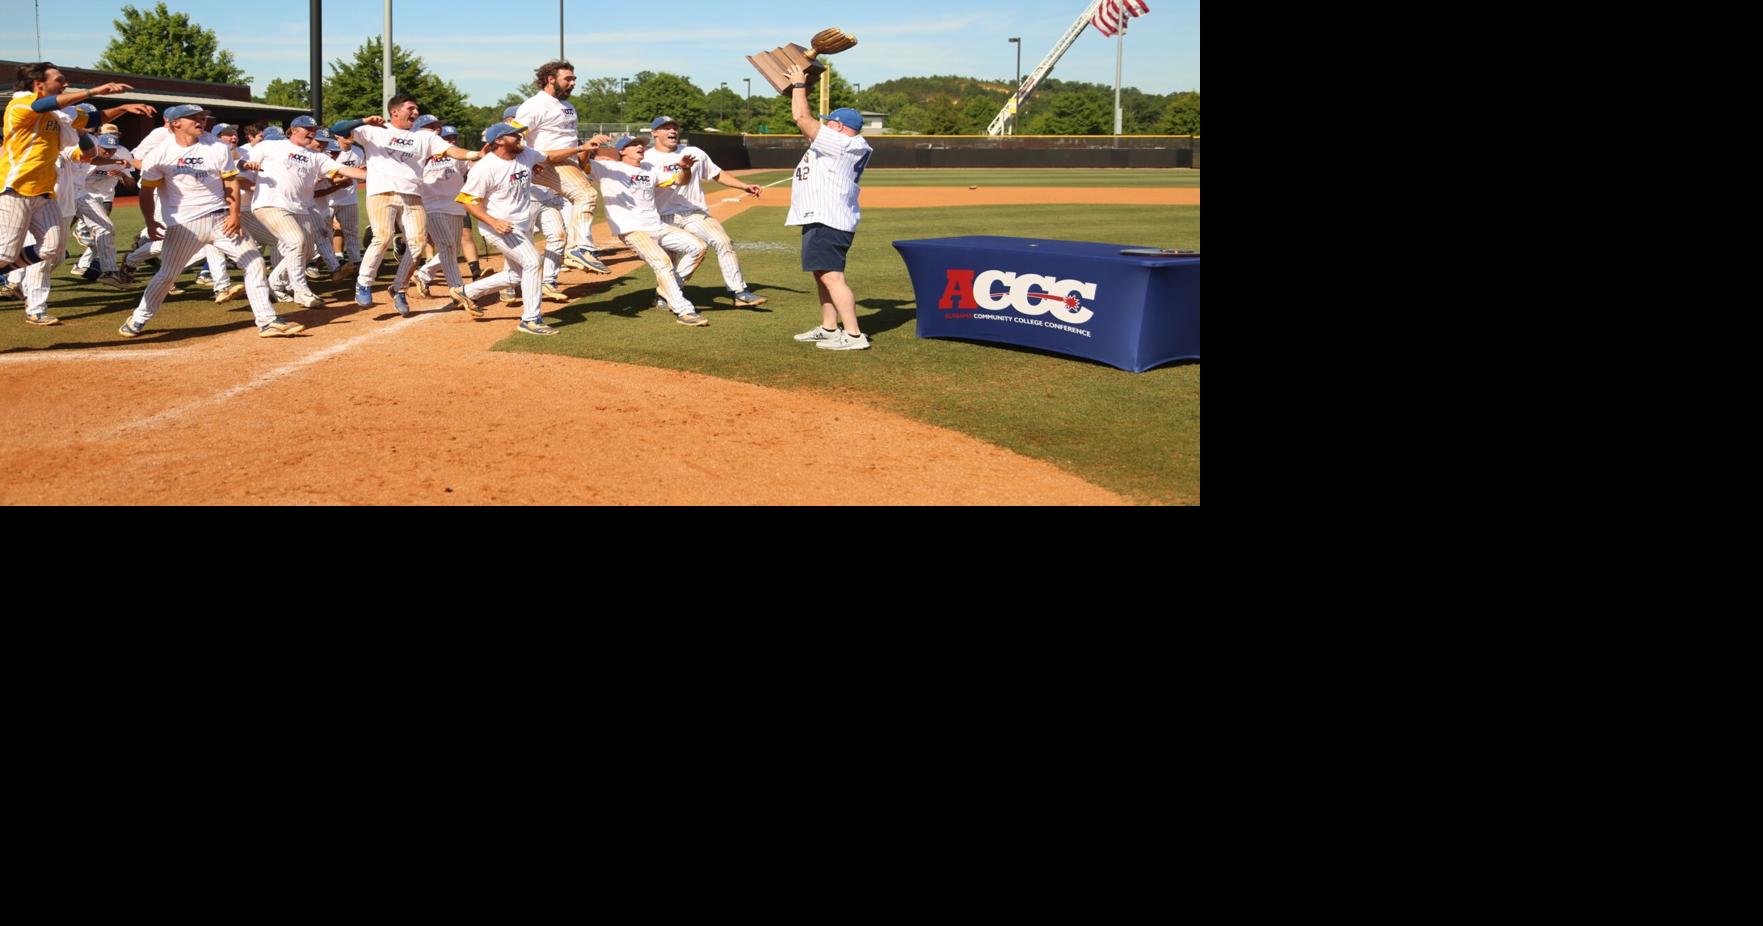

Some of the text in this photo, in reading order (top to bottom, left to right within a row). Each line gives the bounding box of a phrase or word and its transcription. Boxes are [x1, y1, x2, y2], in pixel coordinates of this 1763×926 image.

[795, 166, 810, 181] 42
[938, 268, 1097, 324] ACCC
[973, 313, 1013, 323] COMMUNITY
[1013, 316, 1044, 327] COLLEGE
[1044, 321, 1092, 338] CONFERENCE
